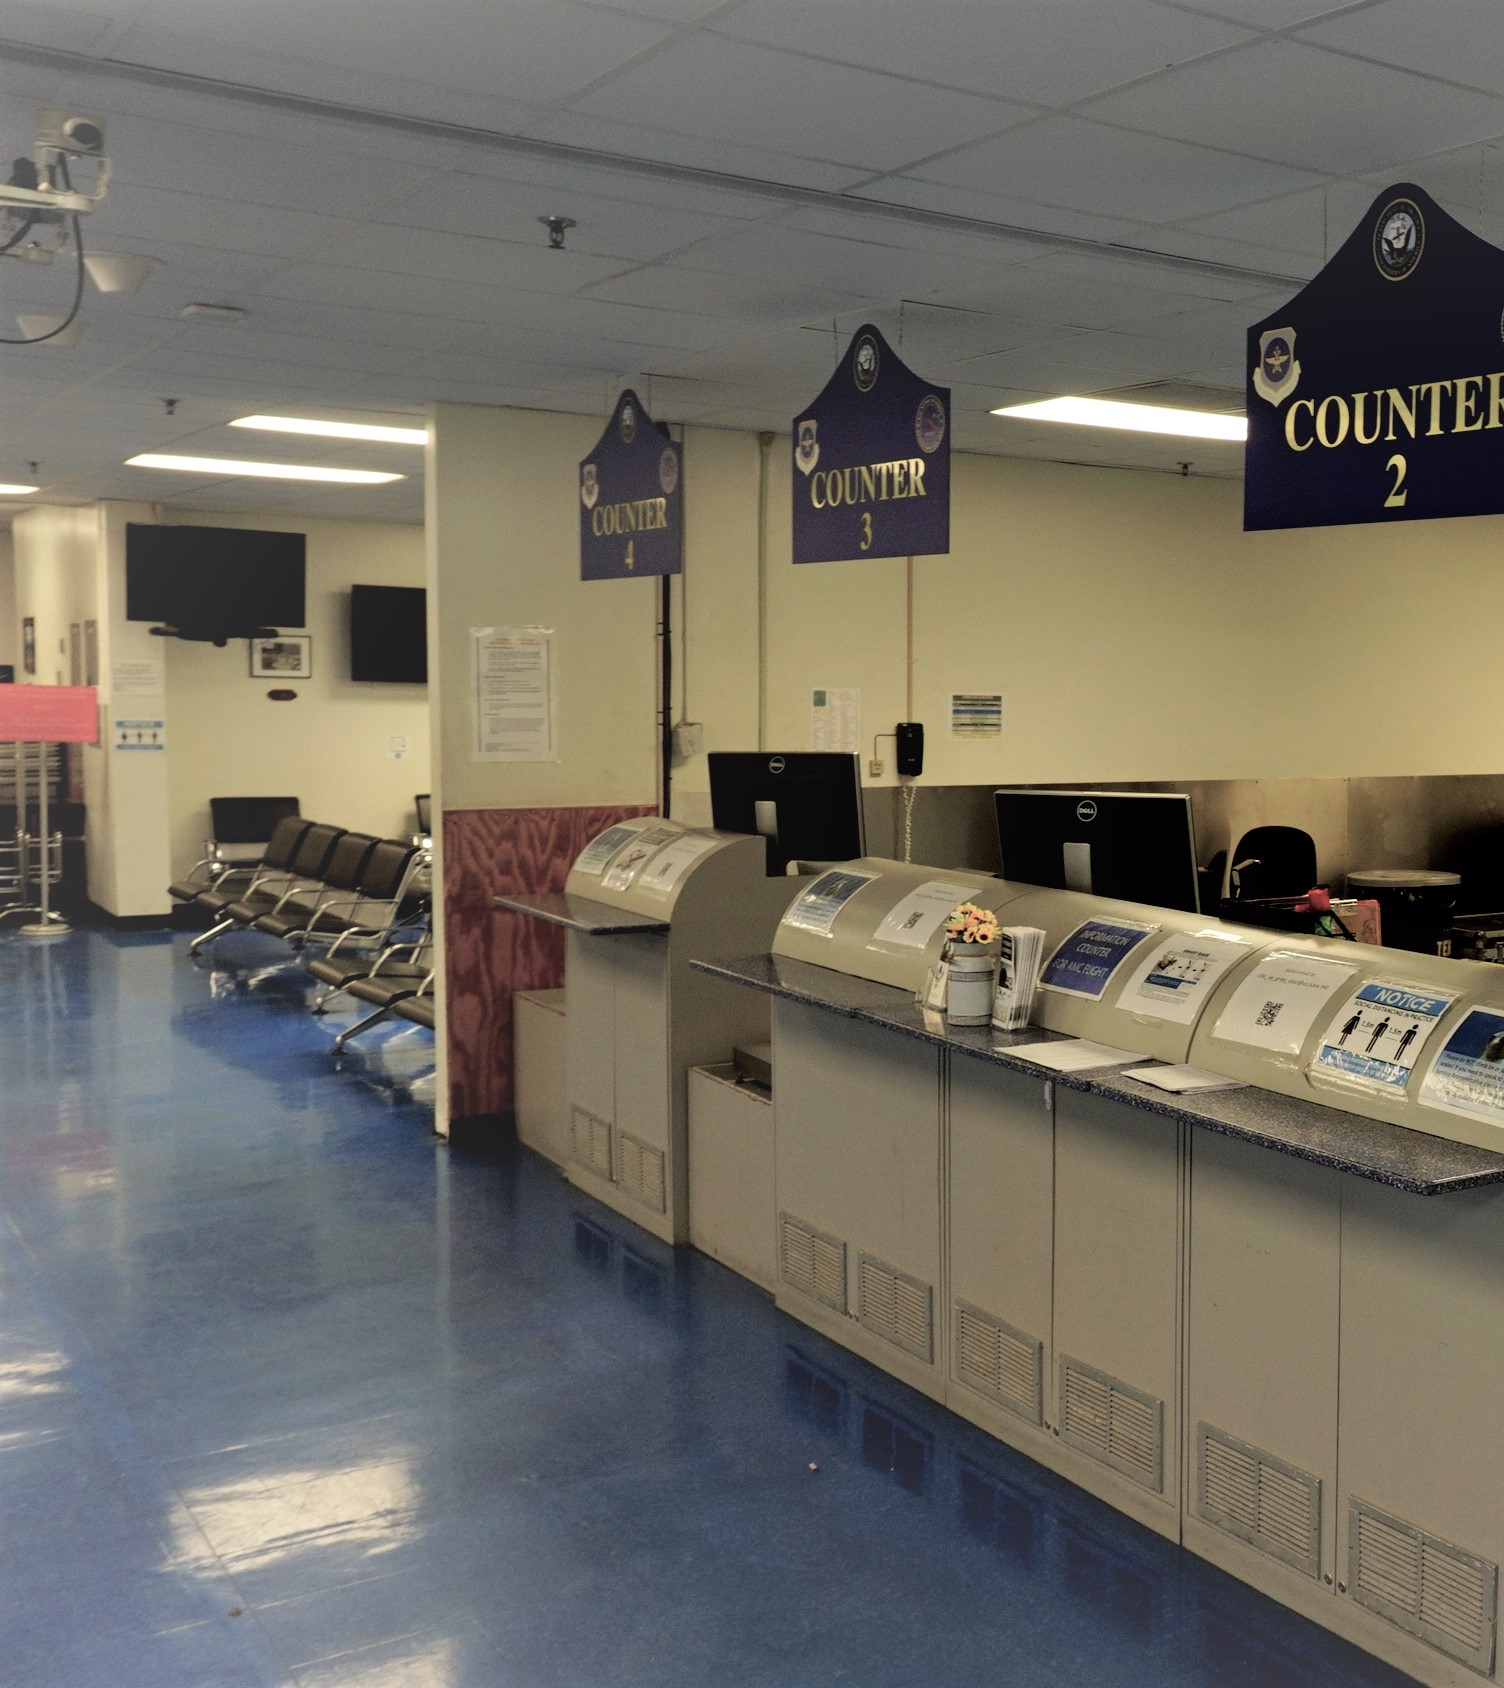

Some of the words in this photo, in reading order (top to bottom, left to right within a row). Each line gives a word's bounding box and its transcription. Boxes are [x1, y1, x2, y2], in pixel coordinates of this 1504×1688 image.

[809, 457, 927, 509] COUNTER
[1383, 454, 1408, 508] 2
[592, 496, 668, 537] COUNTER
[859, 511, 873, 551] 3
[624, 539, 635, 570] 4
[1079, 930, 1132, 946] INFORMATION
[1076, 943, 1112, 958] COUNTER
[1052, 958, 1069, 969] FOR
[1066, 961, 1085, 973] AMC
[1354, 1000, 1372, 1009] SOCIAL
[1372, 1003, 1404, 1017] DISTANCING
[1410, 1013, 1436, 1023] PRACTICE
[1373, 988, 1437, 1012] NOTICE
[1361, 1020, 1375, 1029] 1.5m
[1388, 1027, 1403, 1036] 1.5m
